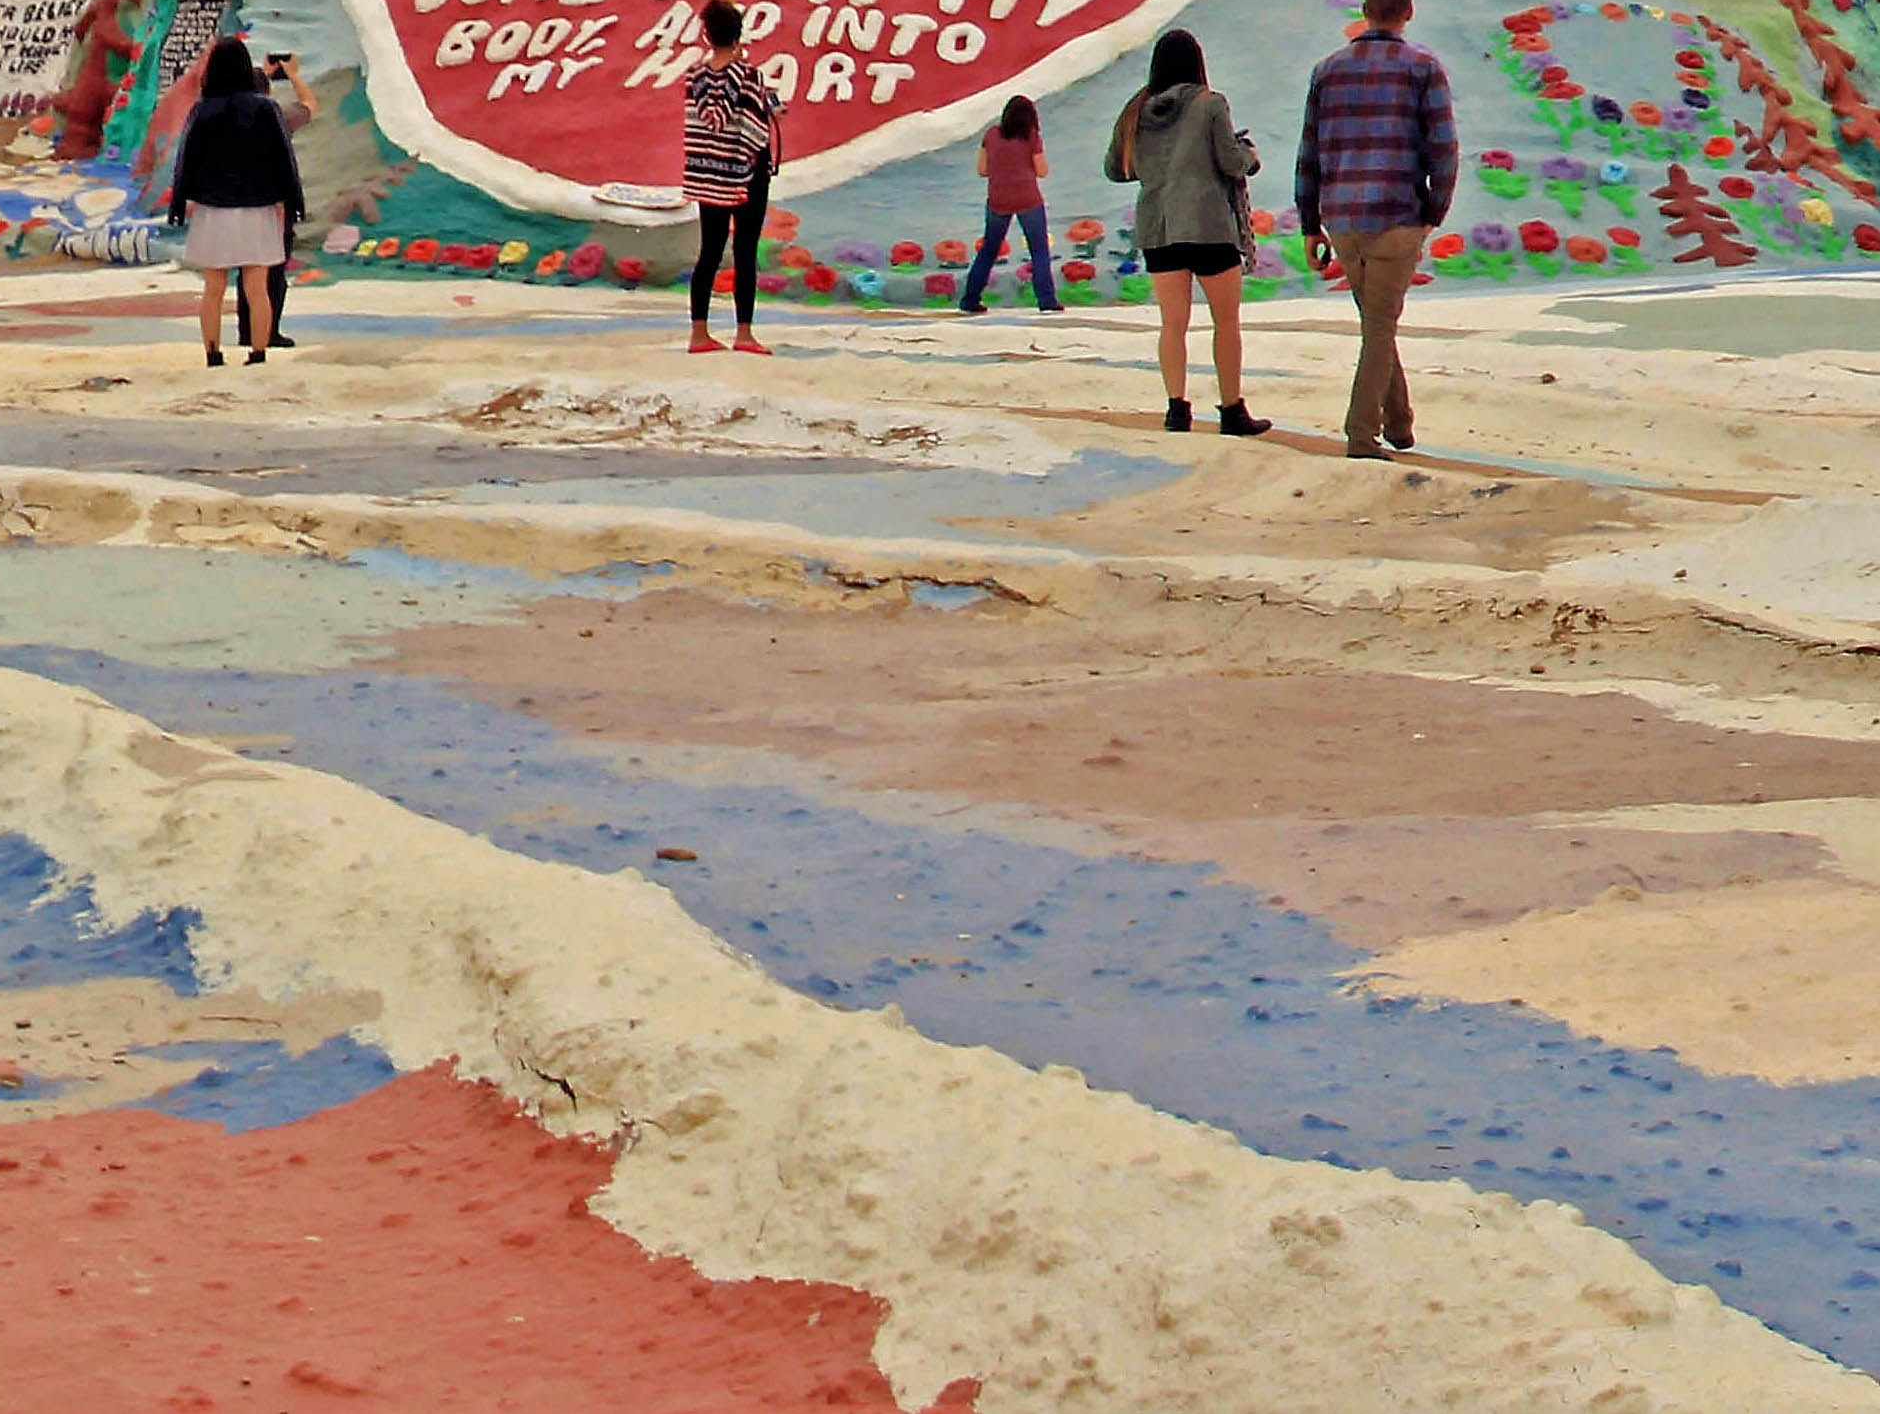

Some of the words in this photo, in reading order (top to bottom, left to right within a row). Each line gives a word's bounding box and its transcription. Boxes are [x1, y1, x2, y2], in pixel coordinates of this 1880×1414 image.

[801, 6, 987, 64] INTO
[487, 57, 604, 101] MY
[624, 47, 915, 103] HART
